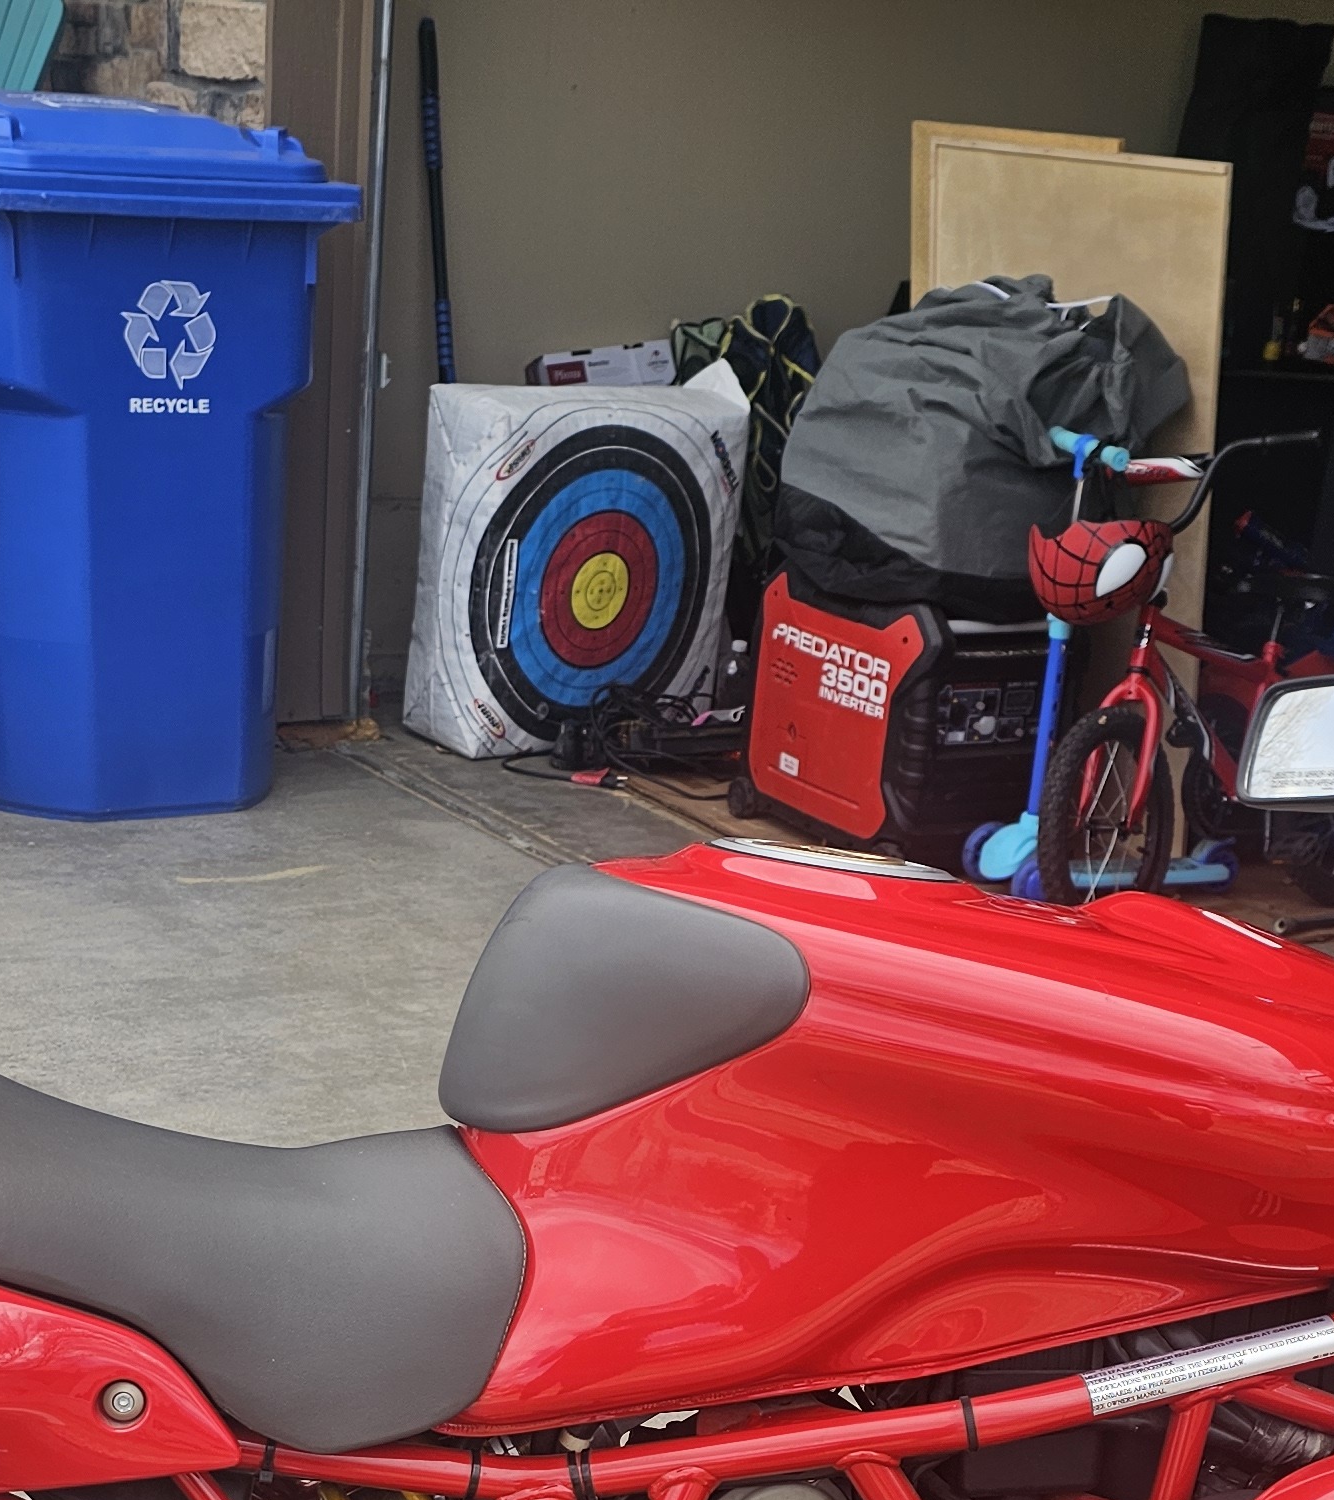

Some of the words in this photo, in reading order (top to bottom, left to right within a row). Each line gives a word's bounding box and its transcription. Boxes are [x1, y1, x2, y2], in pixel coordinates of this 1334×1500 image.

[129, 397, 210, 414] RECYCLE
[772, 623, 891, 682] PREDATOR
[820, 662, 888, 705] 3500
[818, 686, 885, 720] INVERTER
[1247, 1346, 1258, 1354] TO
